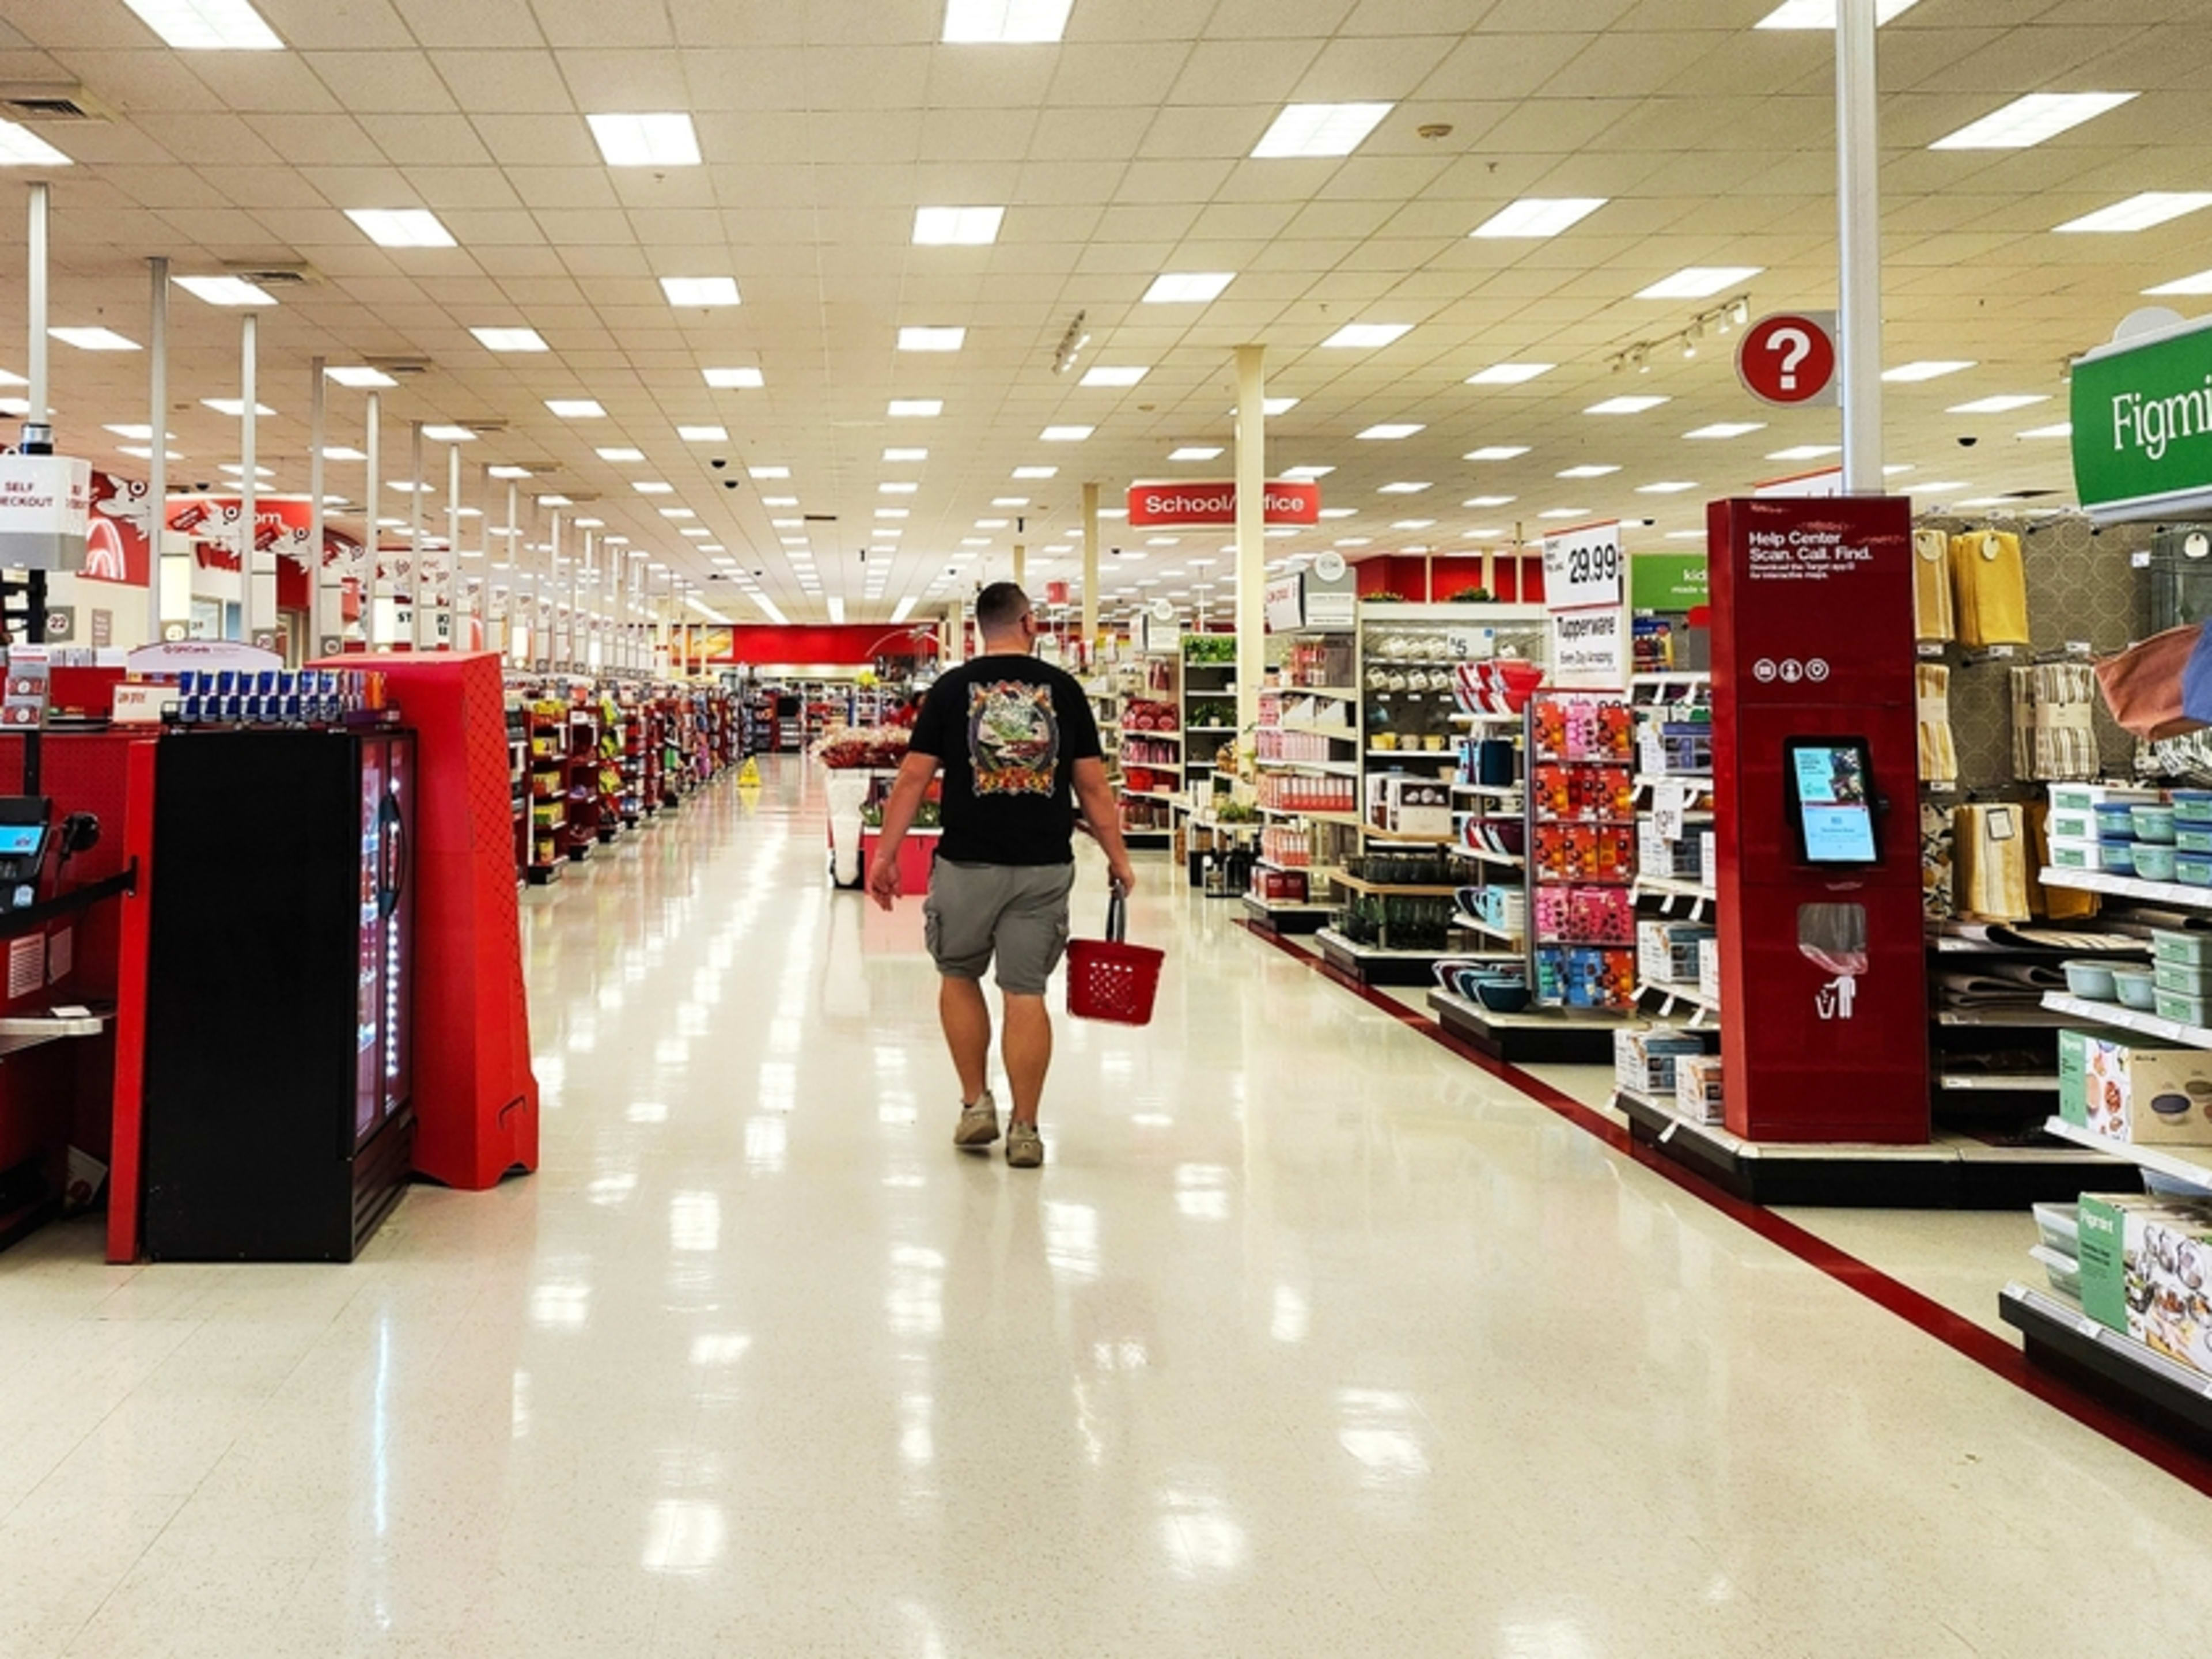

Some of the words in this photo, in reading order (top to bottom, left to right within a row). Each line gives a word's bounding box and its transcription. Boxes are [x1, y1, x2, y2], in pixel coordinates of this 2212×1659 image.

[5, 482, 33, 491] SELF
[1749, 532, 1785, 547] Help
[1788, 531, 1841, 544] Center
[1749, 547, 1794, 562] Scan.
[1797, 547, 1831, 560] Call.
[1835, 546, 1873, 560] Find.
[1568, 543, 1616, 584] 29.99
[50, 616, 67, 628] 22
